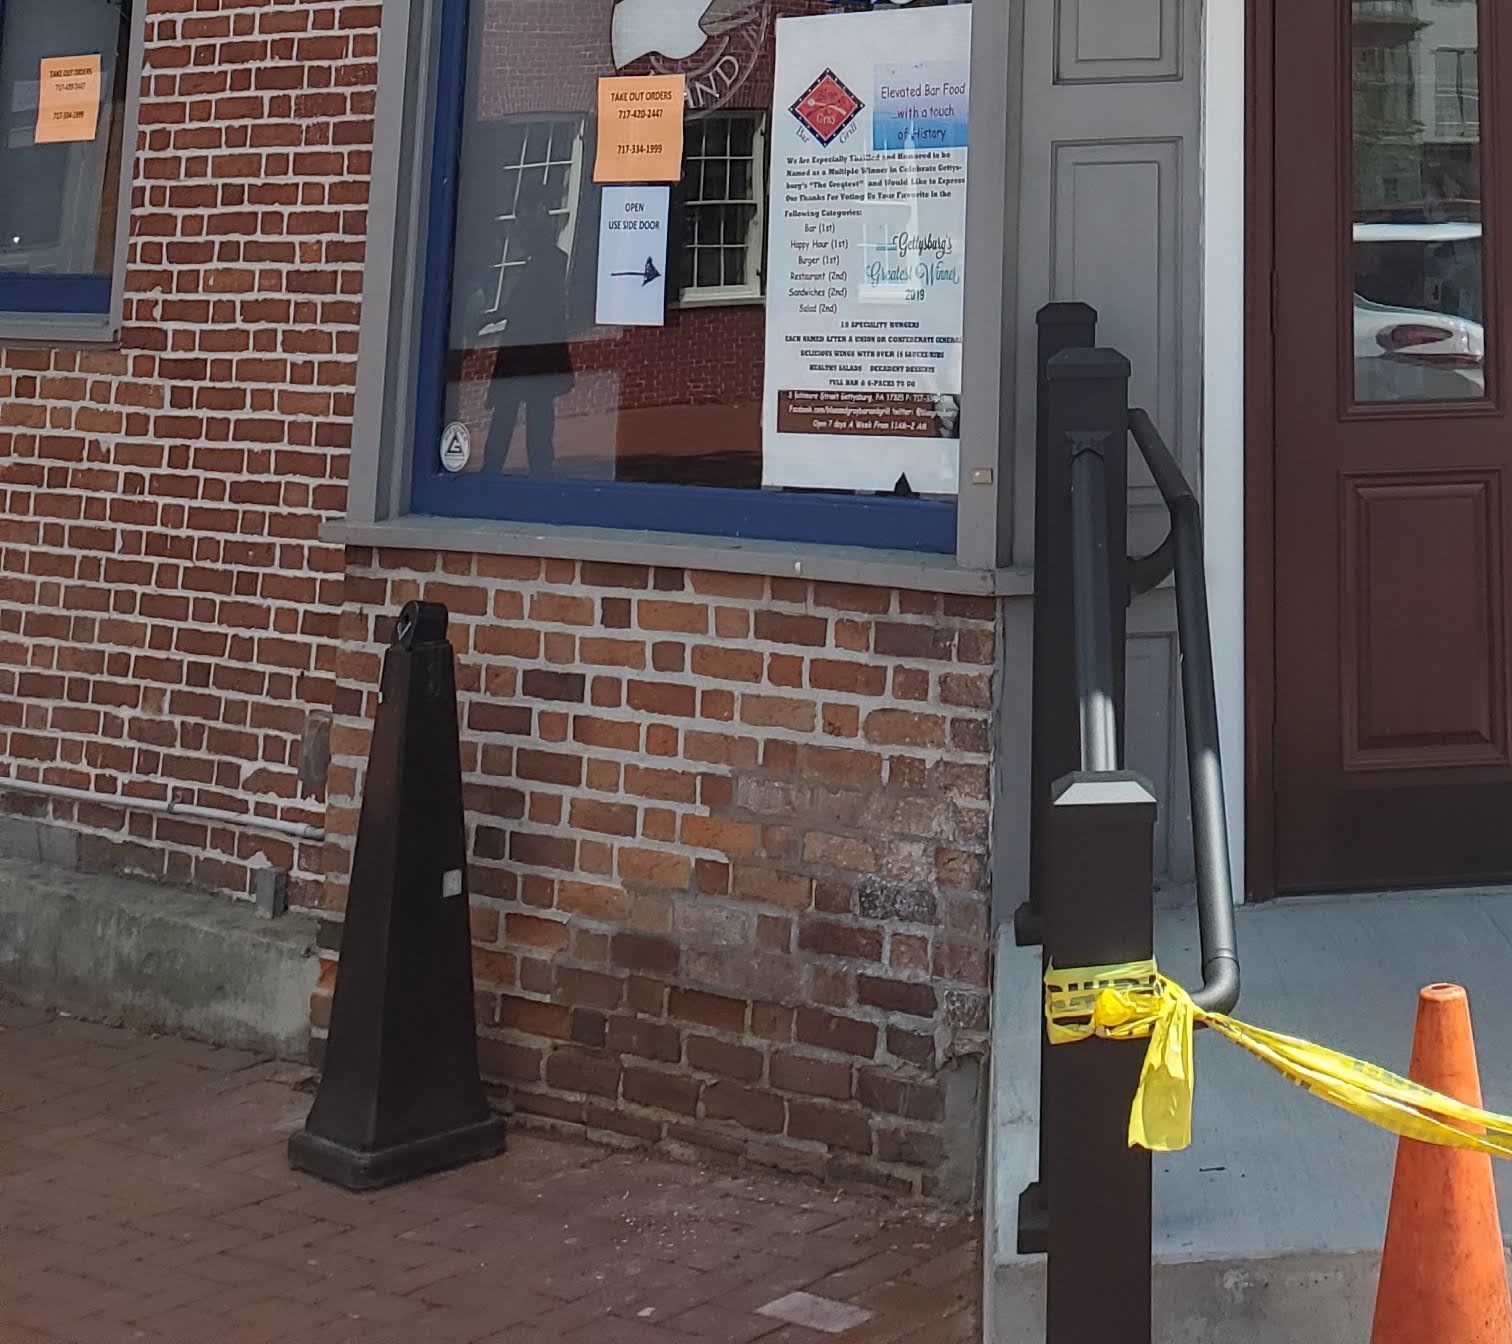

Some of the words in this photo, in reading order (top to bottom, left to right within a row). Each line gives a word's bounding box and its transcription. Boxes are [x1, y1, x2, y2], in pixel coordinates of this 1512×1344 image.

[611, 92, 628, 102] TAKE
[629, 92, 644, 101] OUT
[645, 91, 672, 101] ORDERS
[881, 85, 922, 100] Elevated
[925, 84, 940, 97] Bar
[943, 83, 966, 96] Food
[930, 104, 954, 117] touch
[625, 203, 644, 212] OPEN
[608, 220, 621, 230] USE
[622, 220, 637, 230] SIDE
[639, 220, 660, 230] DOOR
[804, 224, 816, 233] Bar
